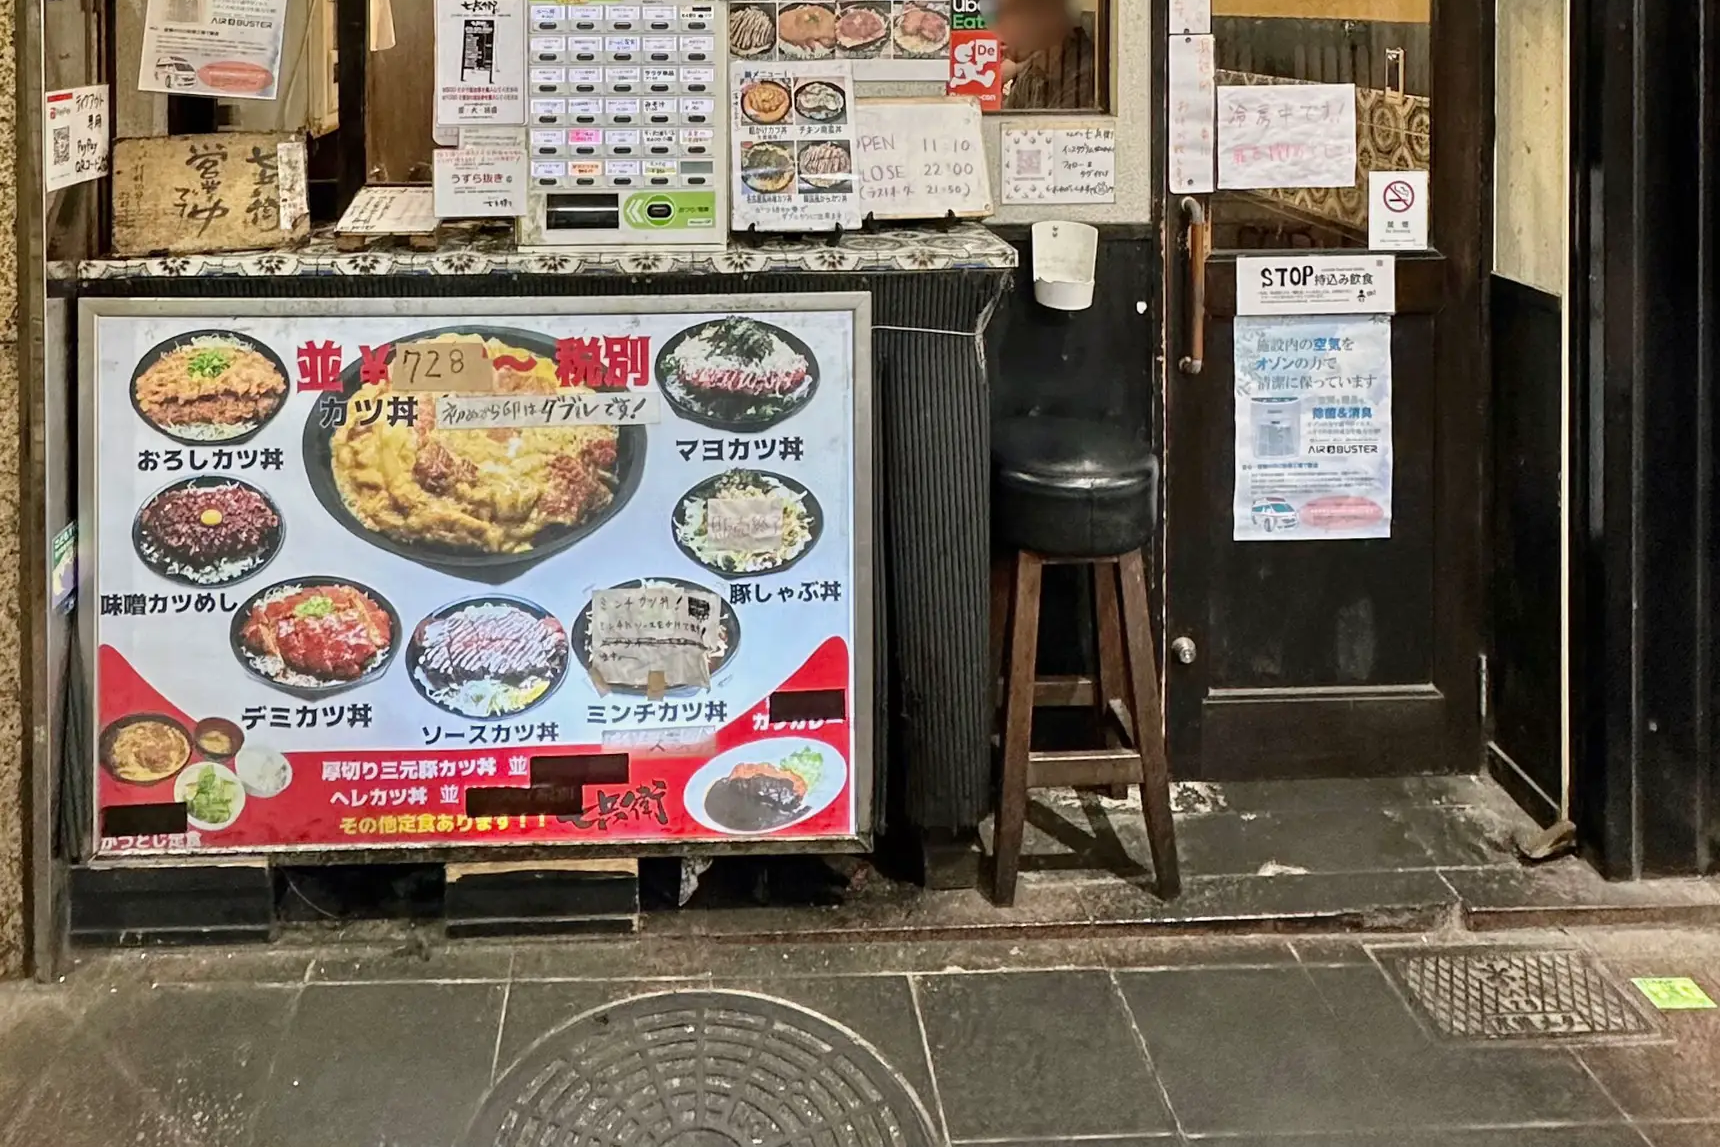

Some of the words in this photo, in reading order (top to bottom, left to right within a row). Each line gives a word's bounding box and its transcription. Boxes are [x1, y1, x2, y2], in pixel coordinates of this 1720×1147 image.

[953, 15, 987, 29] Eat
[859, 164, 906, 182] LOSE
[1260, 265, 1314, 288] STOP
[1314, 273, 1374, 286] 持込み飲食
[1256, 336, 1355, 352] 施設内の空気を
[296, 339, 344, 394] 並
[402, 348, 465, 383] 728
[554, 335, 652, 388] 税別
[1255, 356, 1338, 371] オゾンの力で
[1257, 373, 1377, 390] 清潔に保っています
[320, 395, 418, 428] カツ丼
[137, 448, 284, 472] おろしカツ丼
[675, 436, 804, 462] マヨカツ丼
[100, 593, 239, 616] 味噌カツめし
[729, 581, 842, 605] 豚しゃぶ丼
[241, 703, 373, 730] デミカツ丼
[587, 700, 728, 724] ミンチカツ丼
[422, 721, 559, 745] ソースカツ丼
[321, 759, 497, 782] 厚切り三元豚カツ丼
[508, 755, 527, 776] 並
[329, 785, 428, 808] ヘレカツ丼
[440, 784, 459, 804] 並
